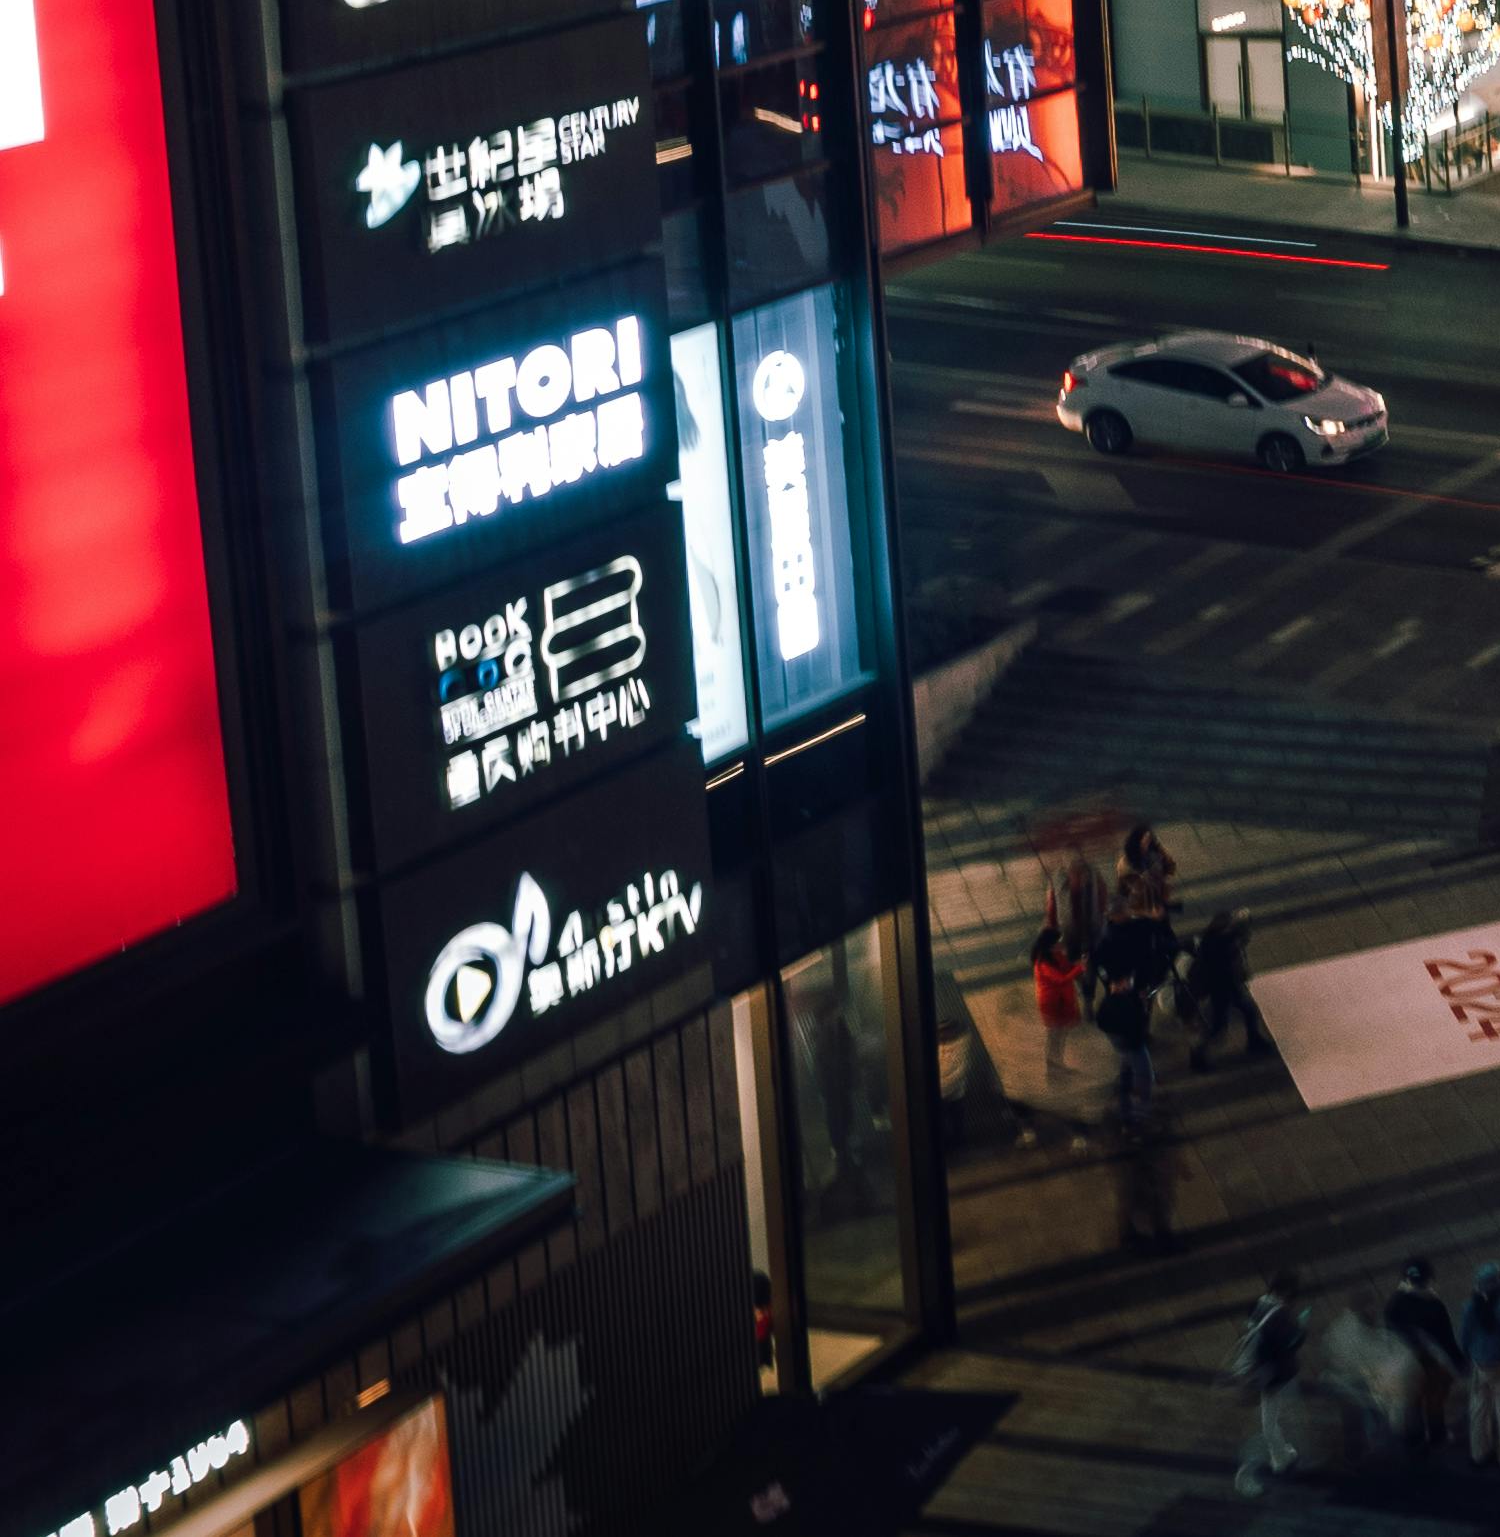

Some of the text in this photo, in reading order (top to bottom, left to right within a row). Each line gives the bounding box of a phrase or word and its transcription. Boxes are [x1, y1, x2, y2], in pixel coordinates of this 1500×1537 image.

[425, 116, 558, 202] 世纪星
[558, 95, 640, 144] CENTURY
[393, 315, 643, 467] NITORI
